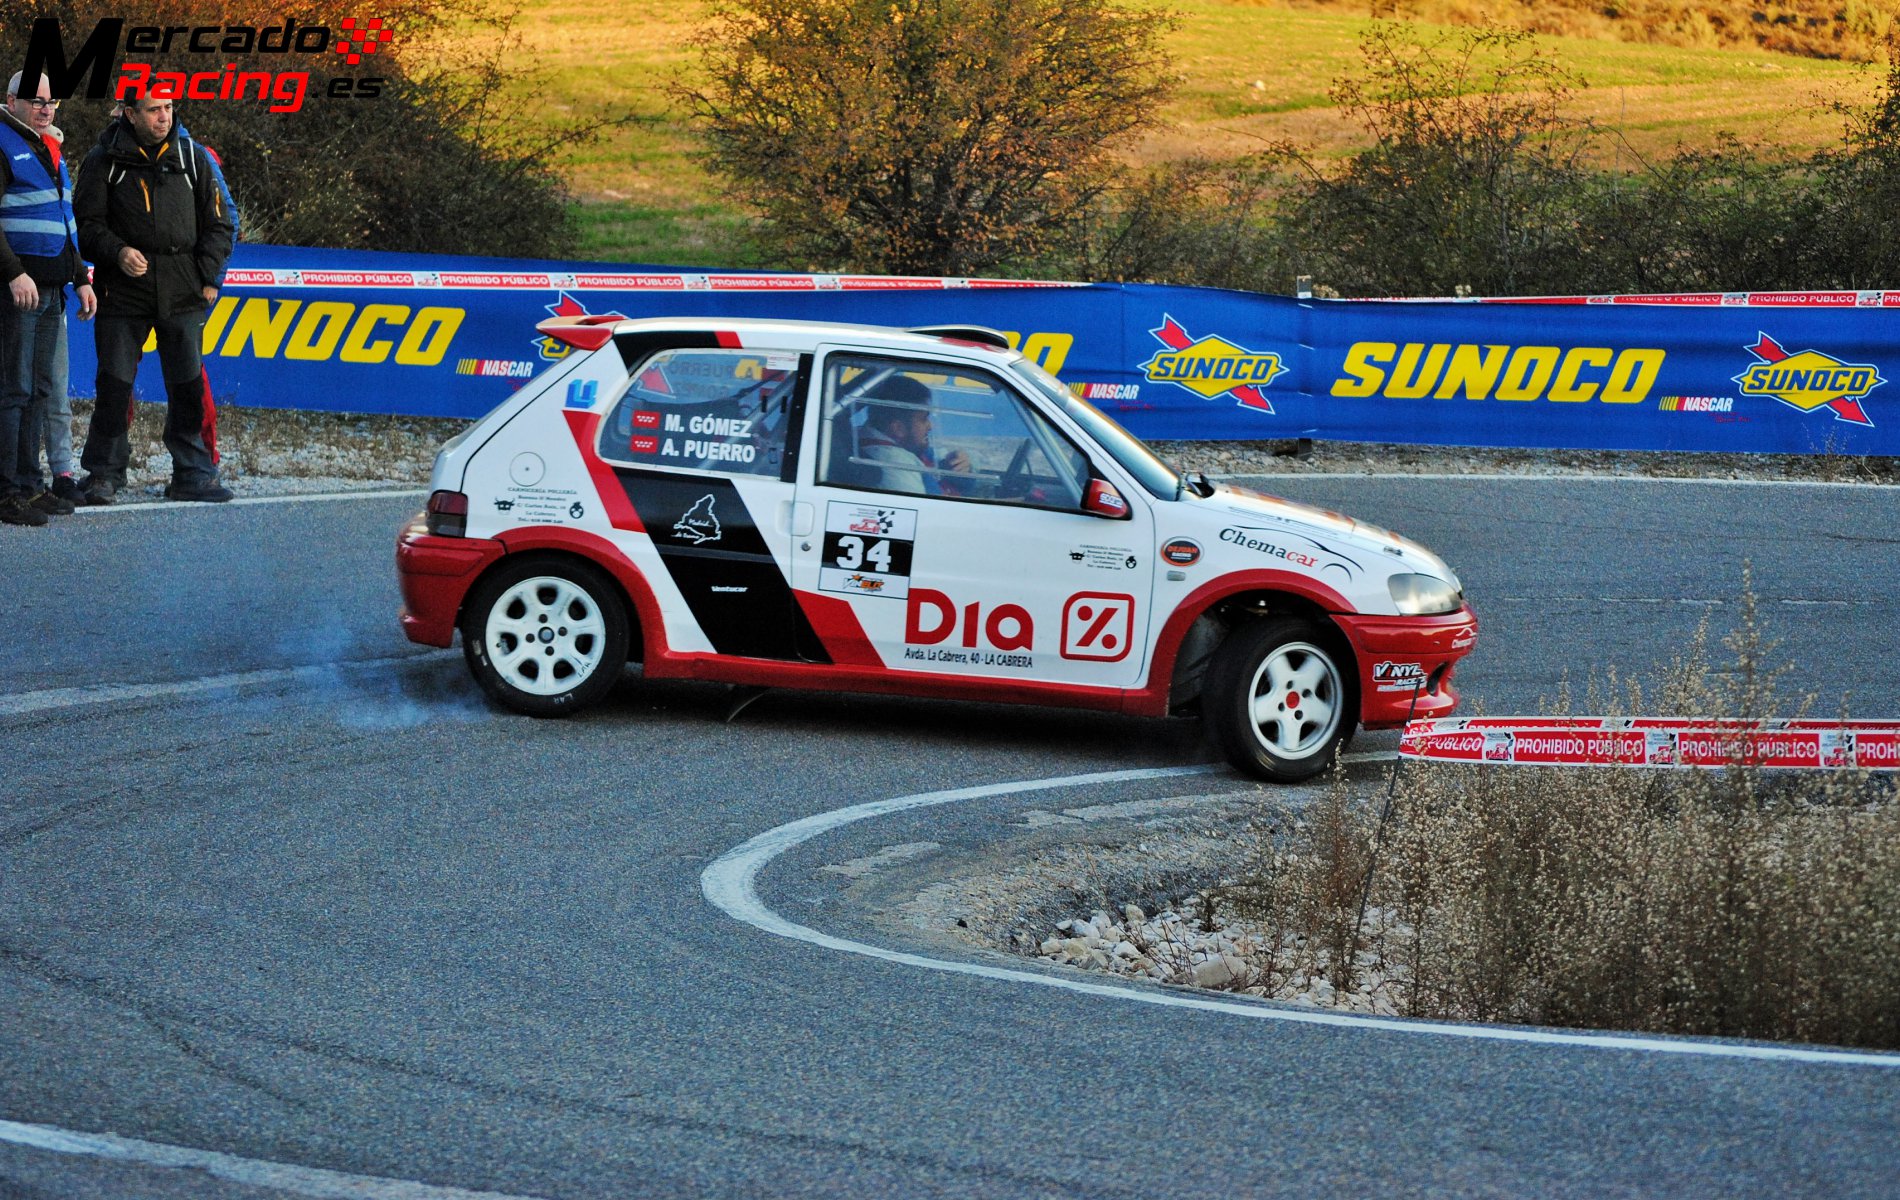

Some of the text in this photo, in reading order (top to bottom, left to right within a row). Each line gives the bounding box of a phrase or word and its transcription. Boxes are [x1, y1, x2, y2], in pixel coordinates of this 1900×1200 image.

[303, 272, 412, 283] PROHIBIDO PÚBLICO
[441, 274, 549, 285] PROHIBIDO PÚBLICO
[577, 276, 682, 286] PROHIBIDO PÚBLICO
[710, 278, 767, 287] PROHIBIDO
[142, 297, 466, 367] NOCO
[482, 361, 534, 378] NASCAR
[1154, 356, 1274, 381] SUNOCO
[1329, 341, 1666, 404] SUNOCO
[1746, 368, 1871, 392] SUNOCO
[1089, 383, 1140, 400] NASCAR
[1683, 396, 1734, 412] NASCAR
[664, 413, 753, 438] M. GÓMEZ
[661, 438, 756, 463] A. PUERRO
[836, 535, 892, 573] 34
[1219, 527, 1319, 568] Chemacar
[904, 647, 926, 660] Avda.
[927, 649, 937, 661] La
[938, 650, 968, 665] Cabrera,
[971, 652, 980, 665] 40
[985, 653, 995, 666] LA
[996, 655, 1033, 668] CABRERA
[1515, 737, 1585, 755] PROHIBIDO
